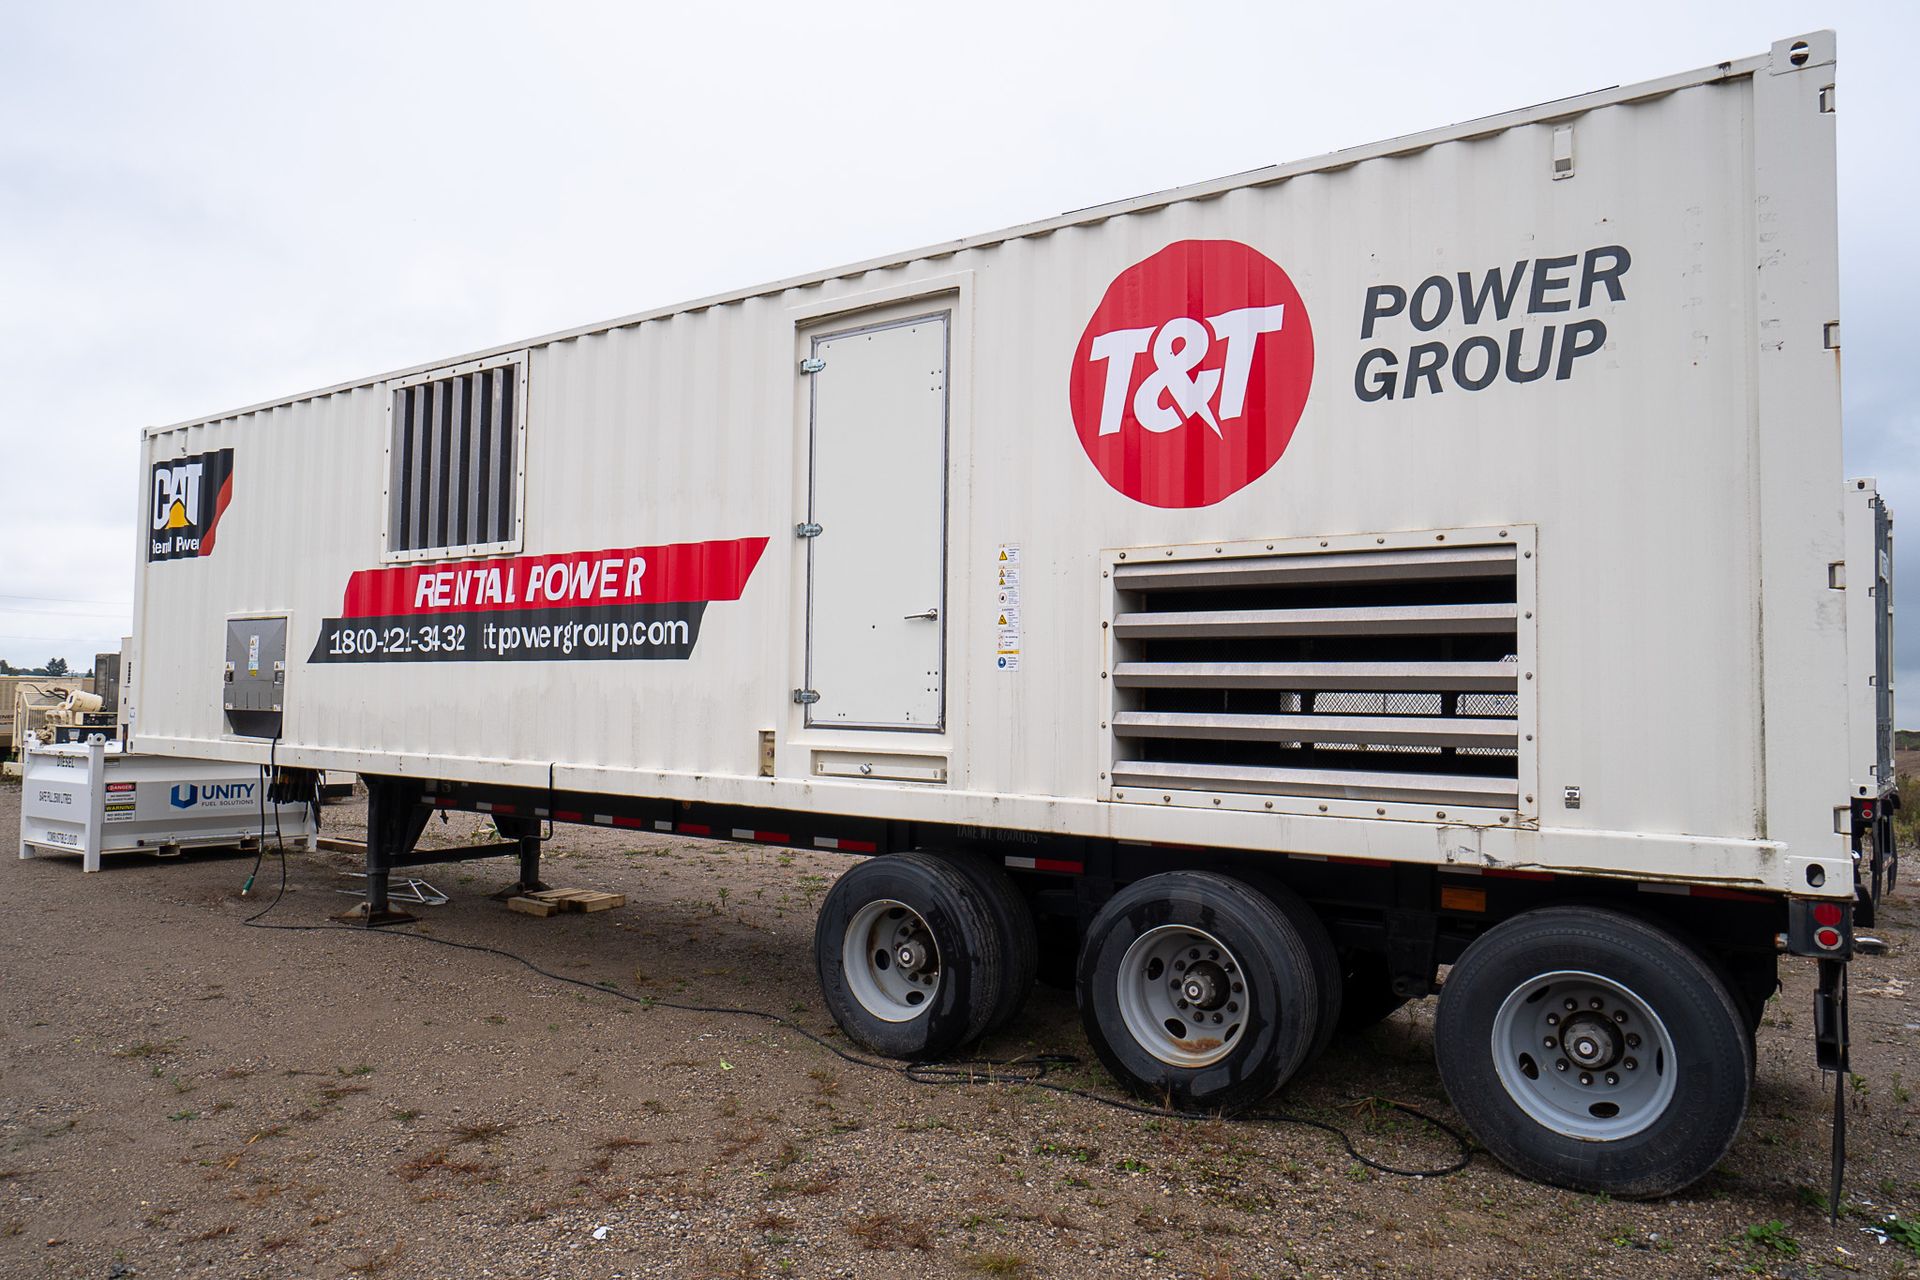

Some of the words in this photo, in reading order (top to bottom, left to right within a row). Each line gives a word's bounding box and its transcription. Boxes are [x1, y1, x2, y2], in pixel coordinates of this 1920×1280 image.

[1360, 244, 1632, 340] POWER
[1088, 303, 1284, 440] T&T
[1354, 318, 1608, 403] GROUP
[153, 463, 203, 530] CAT
[414, 567, 516, 608] RENTAL
[525, 556, 647, 602] POWER
[202, 783, 255, 800] UNITY
